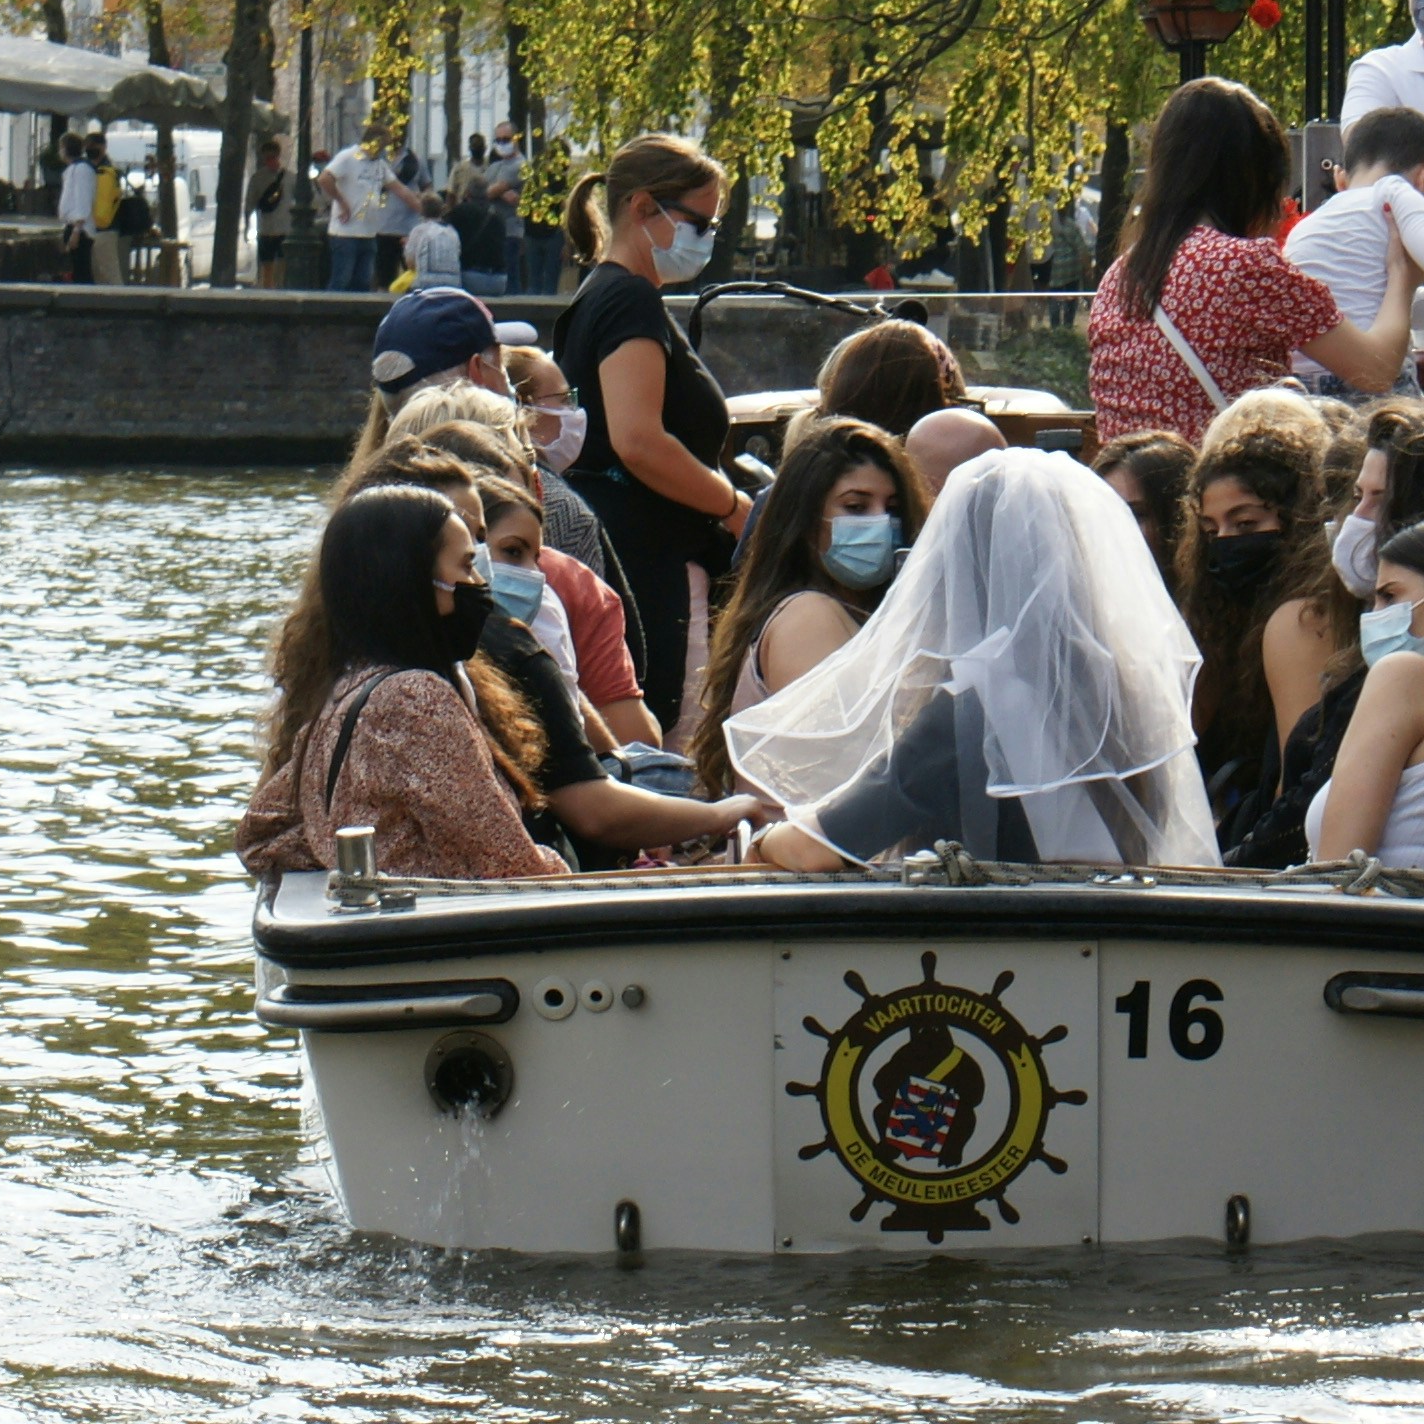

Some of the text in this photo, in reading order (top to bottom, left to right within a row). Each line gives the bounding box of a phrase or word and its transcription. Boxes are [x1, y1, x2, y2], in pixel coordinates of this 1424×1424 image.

[863, 993, 1007, 1036] VAARTTOCHTEN
[1114, 978, 1225, 1061] 16
[845, 1140, 1025, 1201] DE MEULEMEESTER
